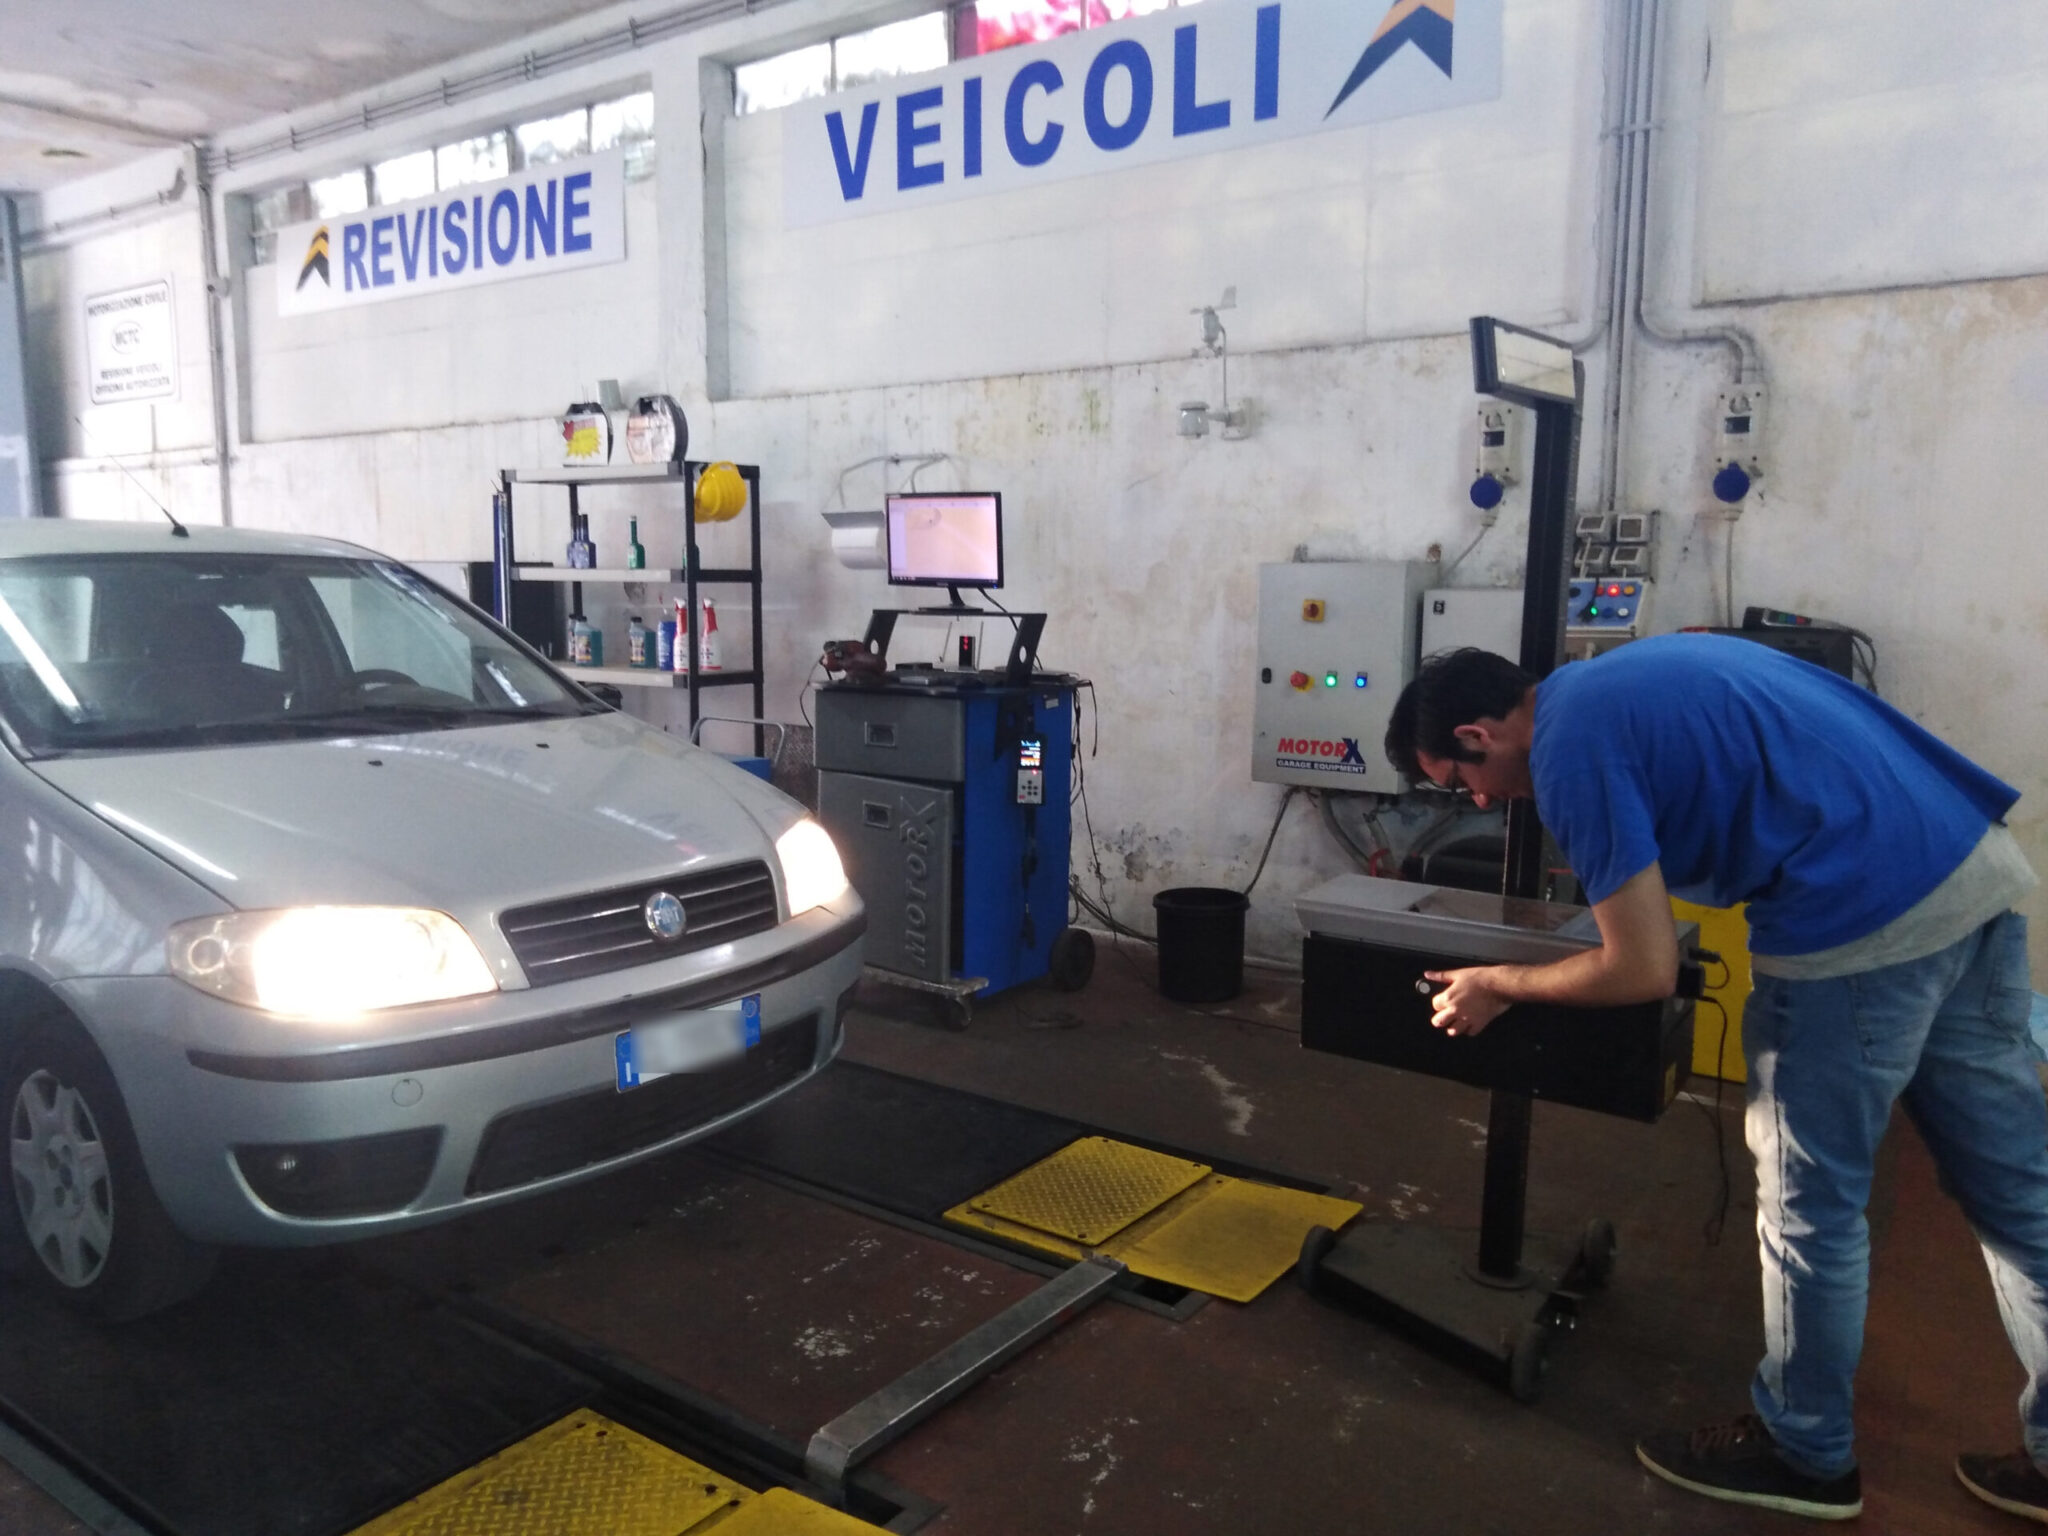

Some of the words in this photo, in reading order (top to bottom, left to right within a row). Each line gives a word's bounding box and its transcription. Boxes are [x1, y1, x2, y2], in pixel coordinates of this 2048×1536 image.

[824, 3, 1281, 203] VEICOLI
[342, 171, 592, 293] REVISIONE
[1278, 760, 1312, 769] GARAGE
[1313, 763, 1364, 773] EQUIPMENT
